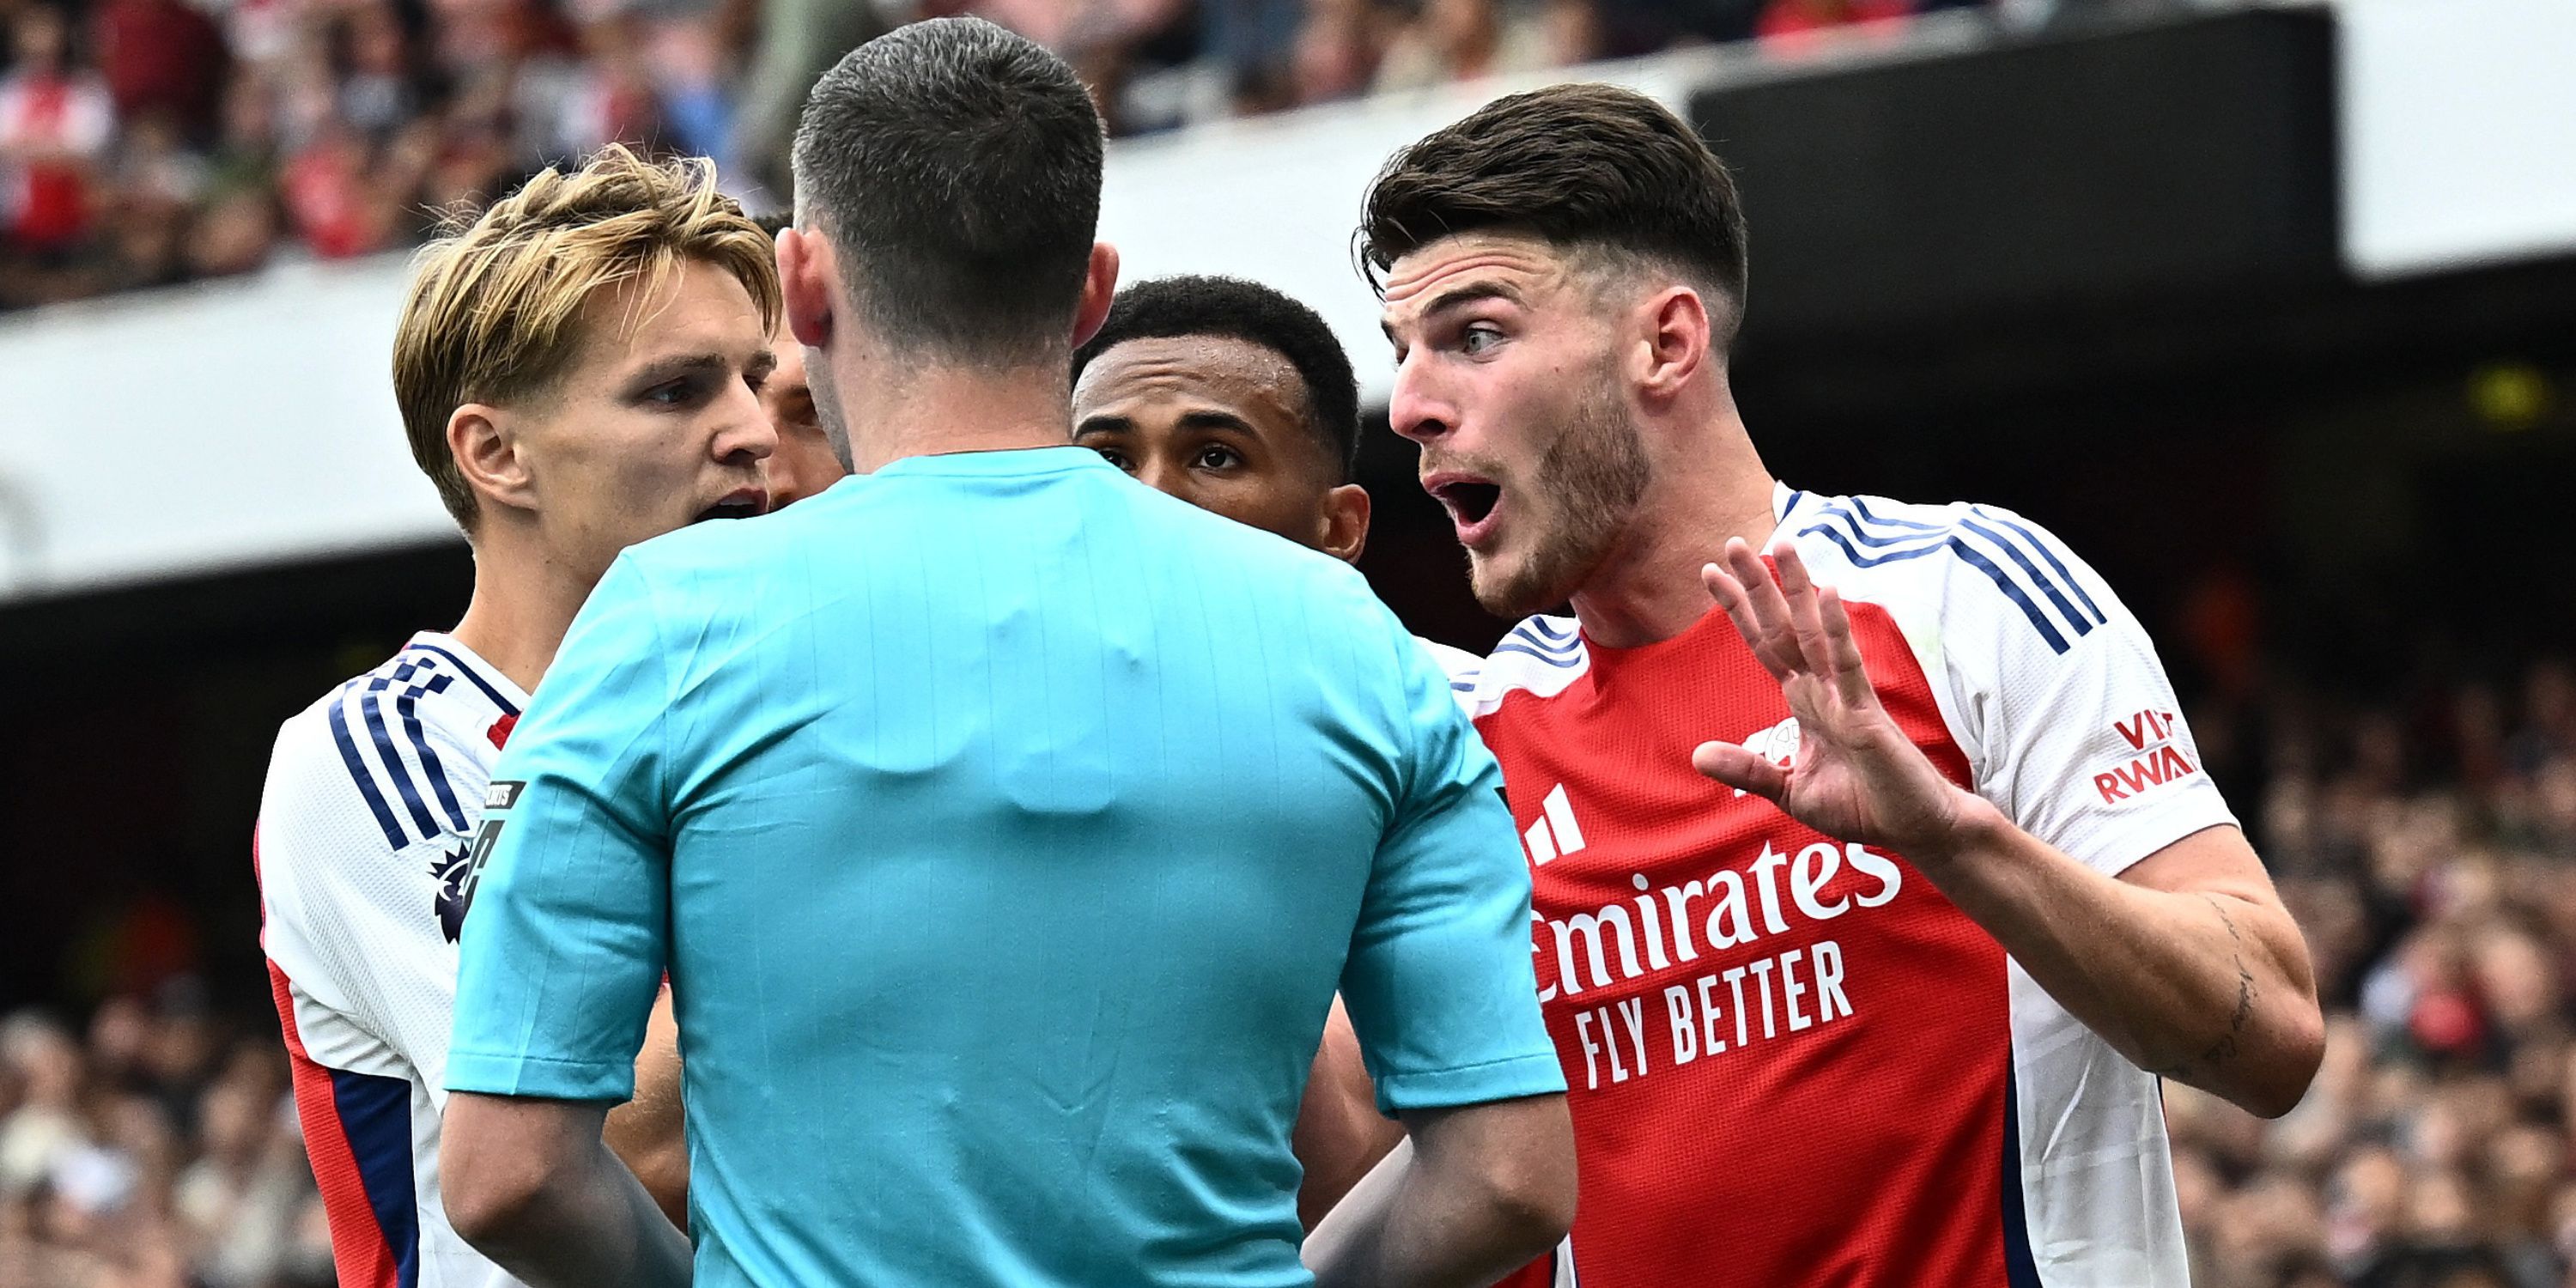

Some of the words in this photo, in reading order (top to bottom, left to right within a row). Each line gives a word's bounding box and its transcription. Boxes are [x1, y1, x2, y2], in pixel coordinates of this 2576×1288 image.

[2093, 745, 2198, 804] RWA
[1575, 996, 1648, 1091] FLY
[1663, 940, 1854, 1066] BETTER
